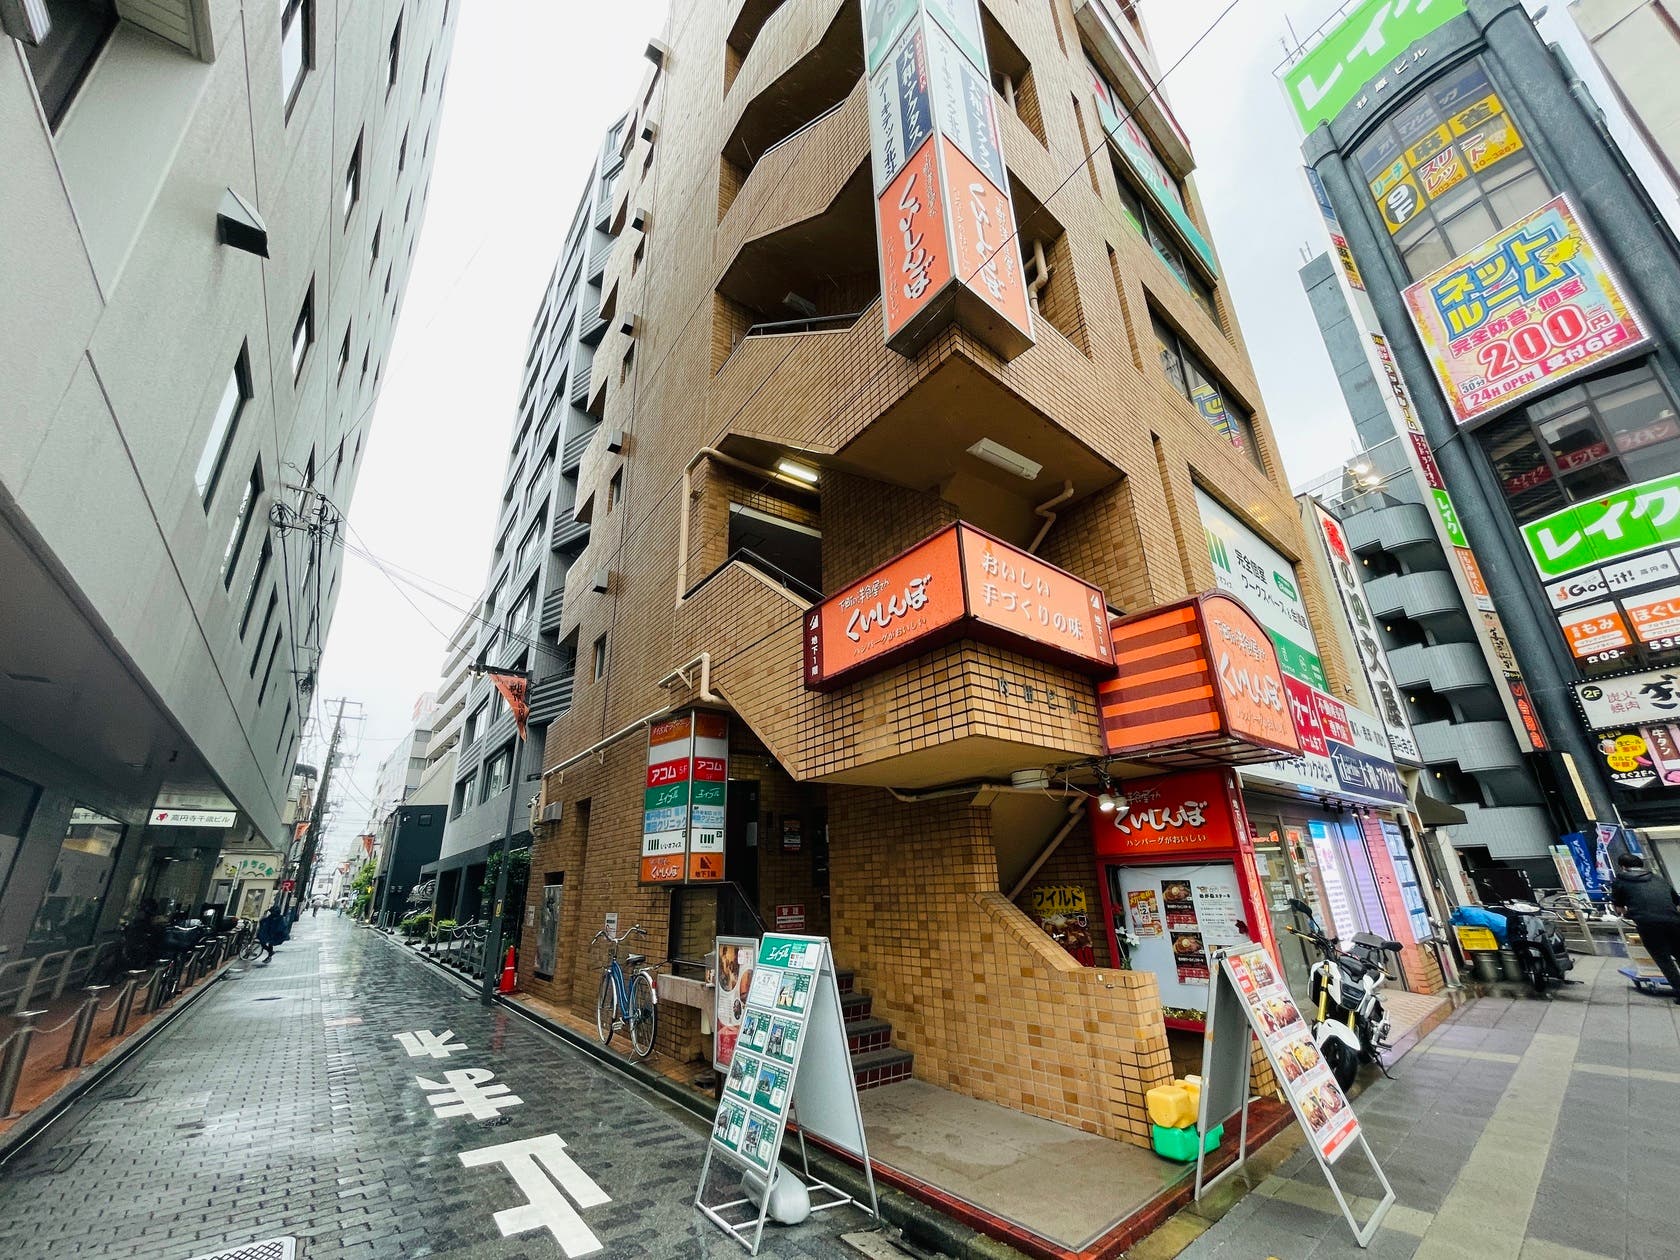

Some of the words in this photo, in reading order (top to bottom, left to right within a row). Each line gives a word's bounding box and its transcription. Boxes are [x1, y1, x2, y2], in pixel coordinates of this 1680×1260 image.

[878, 76, 899, 181] アーキテック北斗
[1386, 183, 1417, 223] 9F
[898, 173, 936, 300] くいしんぼ
[1438, 236, 1548, 304] ネット
[1451, 262, 1571, 335] ルーム
[1451, 279, 1586, 357] 完全防音・個室
[1546, 328, 1621, 372] 受付6F
[1469, 386, 1501, 407] 24H
[1503, 371, 1536, 391] OPEN
[1435, 496, 1461, 537] レイク
[1537, 486, 1680, 562] レイク
[980, 551, 1052, 598] おいしい
[845, 573, 933, 642] くいしんぼ
[981, 583, 1084, 641] 手づくりの味
[1582, 617, 1615, 635] もみ
[809, 634, 820, 677] 地下1階
[853, 617, 928, 658] ハンバーグがおいしい
[1217, 652, 1285, 714] くいしんぼ
[1583, 689, 1602, 699] 2F
[1606, 690, 1637, 703] 炭火
[1651, 728, 1671, 755] 牛タン
[651, 765, 677, 783] アコム
[697, 760, 723, 772] アコム
[1114, 800, 1208, 834] くいしんぼ
[660, 842, 682, 850] いいオフィス
[1126, 835, 1206, 847] ハンバーグがおいしい
[651, 865, 680, 879] くいしんぼ
